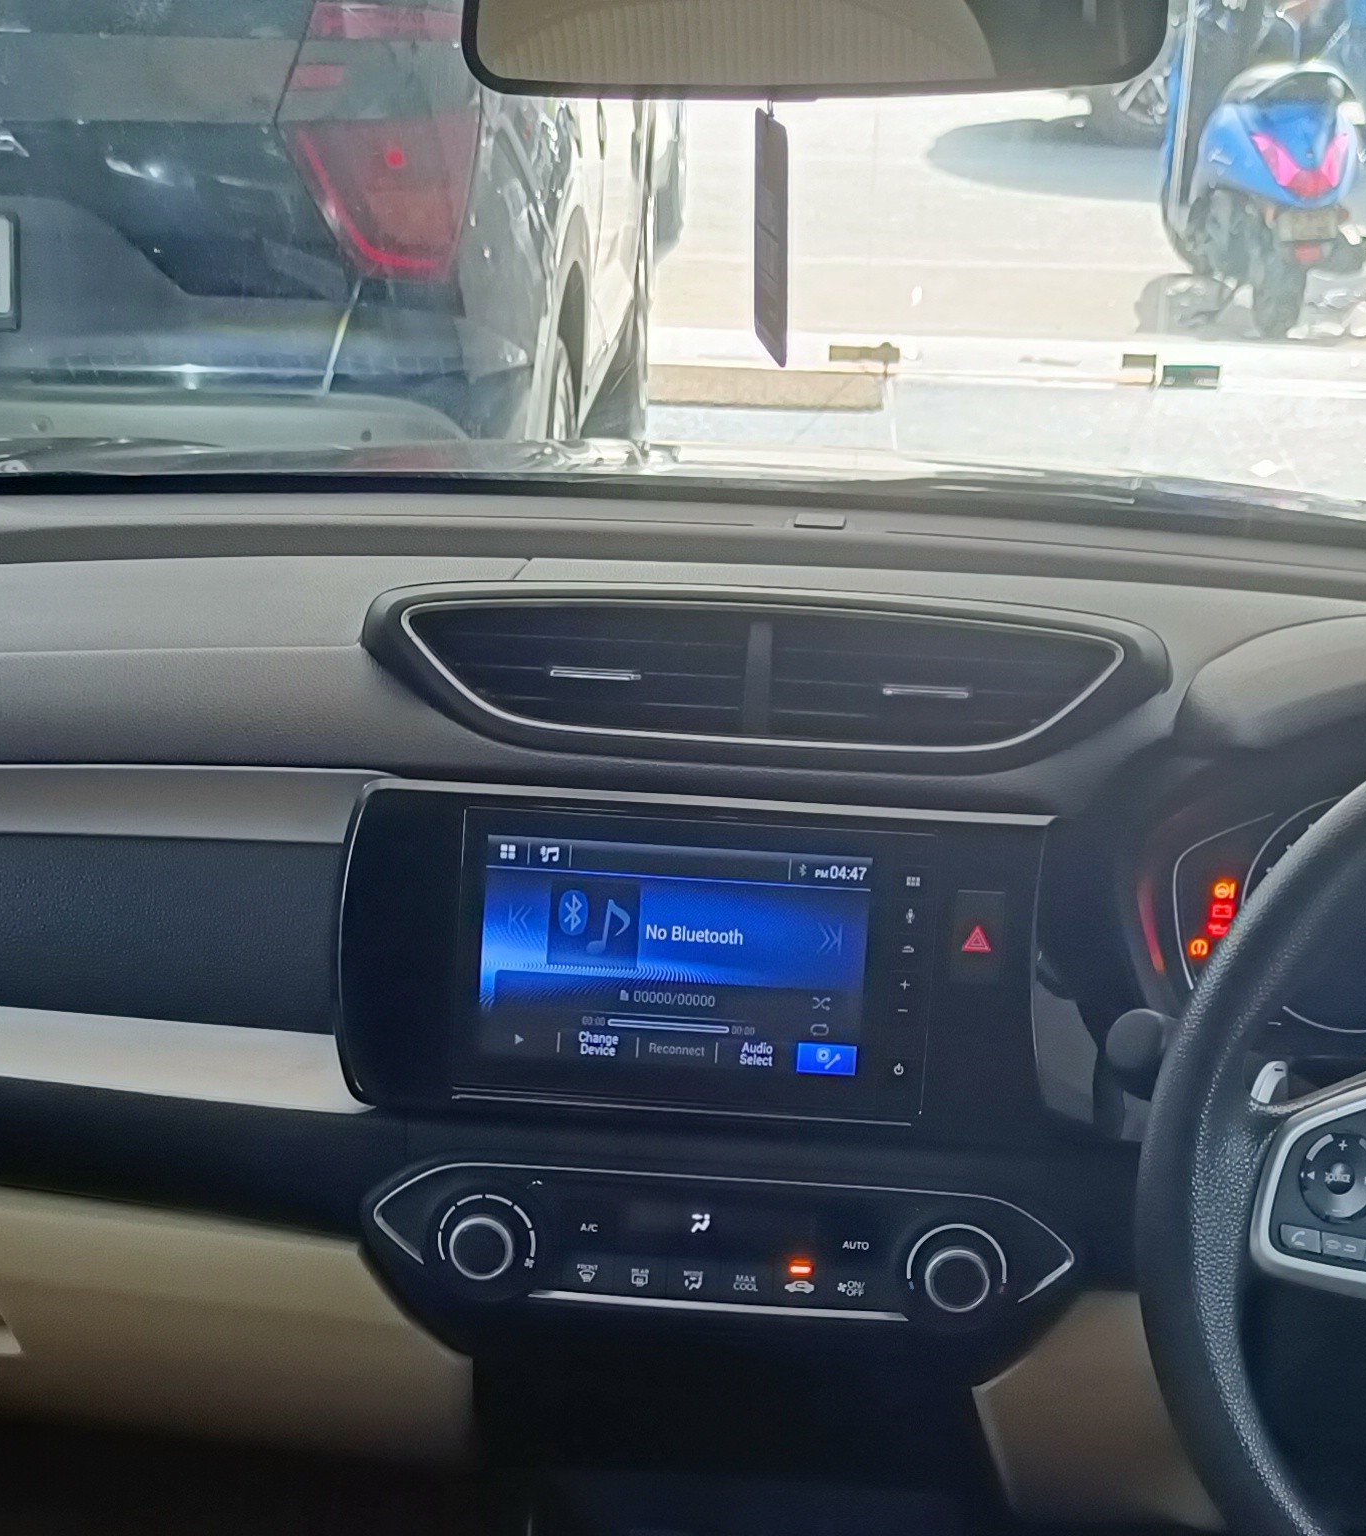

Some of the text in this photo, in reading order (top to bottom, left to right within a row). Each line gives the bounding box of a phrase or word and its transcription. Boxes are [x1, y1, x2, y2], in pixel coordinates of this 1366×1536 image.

[814, 865, 868, 881] PM 04:47
[645, 924, 744, 945] No Bluetooth
[633, 990, 716, 1008] 00000/00000
[578, 1031, 619, 1046] Change
[580, 1044, 617, 1057] Device
[648, 1043, 705, 1057] Reconnect
[741, 1041, 774, 1055] Audio
[739, 1053, 774, 1067] Select
[580, 1223, 598, 1233] A/C
[842, 1240, 870, 1250] AUTO
[576, 1263, 598, 1271] FRONT
[735, 1274, 756, 1283] MAX
[733, 1282, 758, 1291] COOL
[846, 1288, 865, 1297] OFF
